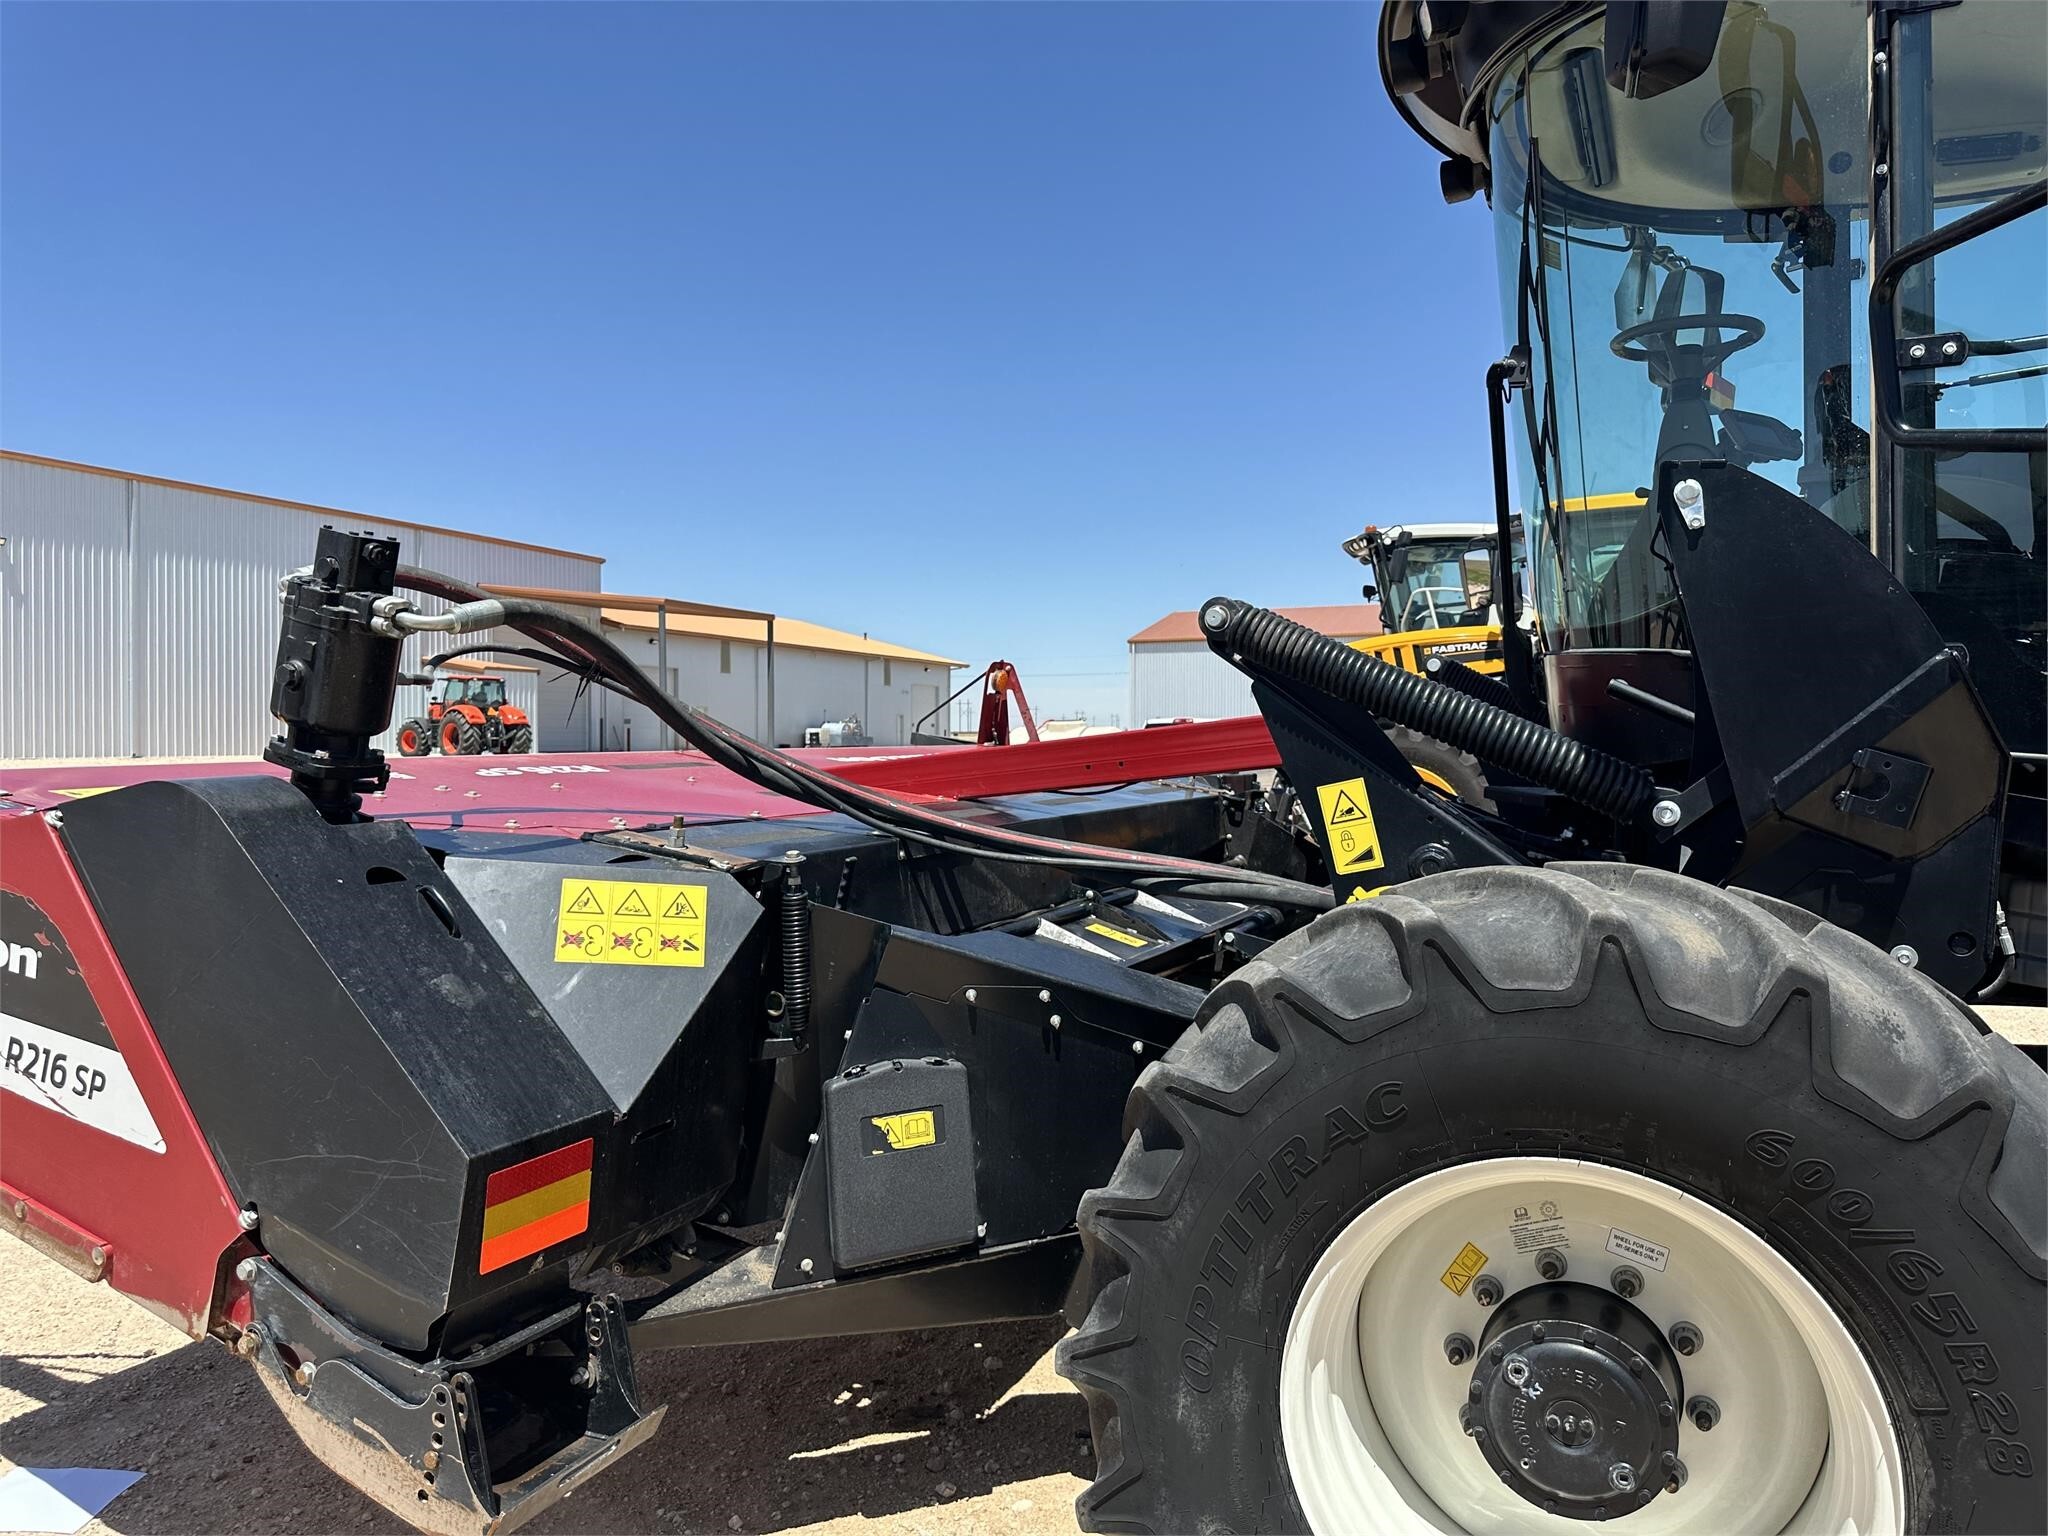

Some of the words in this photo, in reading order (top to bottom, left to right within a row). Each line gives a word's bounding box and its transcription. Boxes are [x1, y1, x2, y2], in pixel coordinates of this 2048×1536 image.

[1432, 641, 1488, 654] FASTRAC
[5, 1036, 68, 1089] R216
[72, 1064, 106, 1100] SP
[1180, 1081, 1408, 1394] OPTITRAC
[1278, 1208, 1311, 1251] ROTATION
[1613, 1234, 1631, 1245] WHEEL
[1632, 1241, 1644, 1250] FOR
[1644, 1246, 1655, 1254] USE
[1643, 1253, 1659, 1262] ONLY
[1745, 1129, 2034, 1478] 600/65R28
